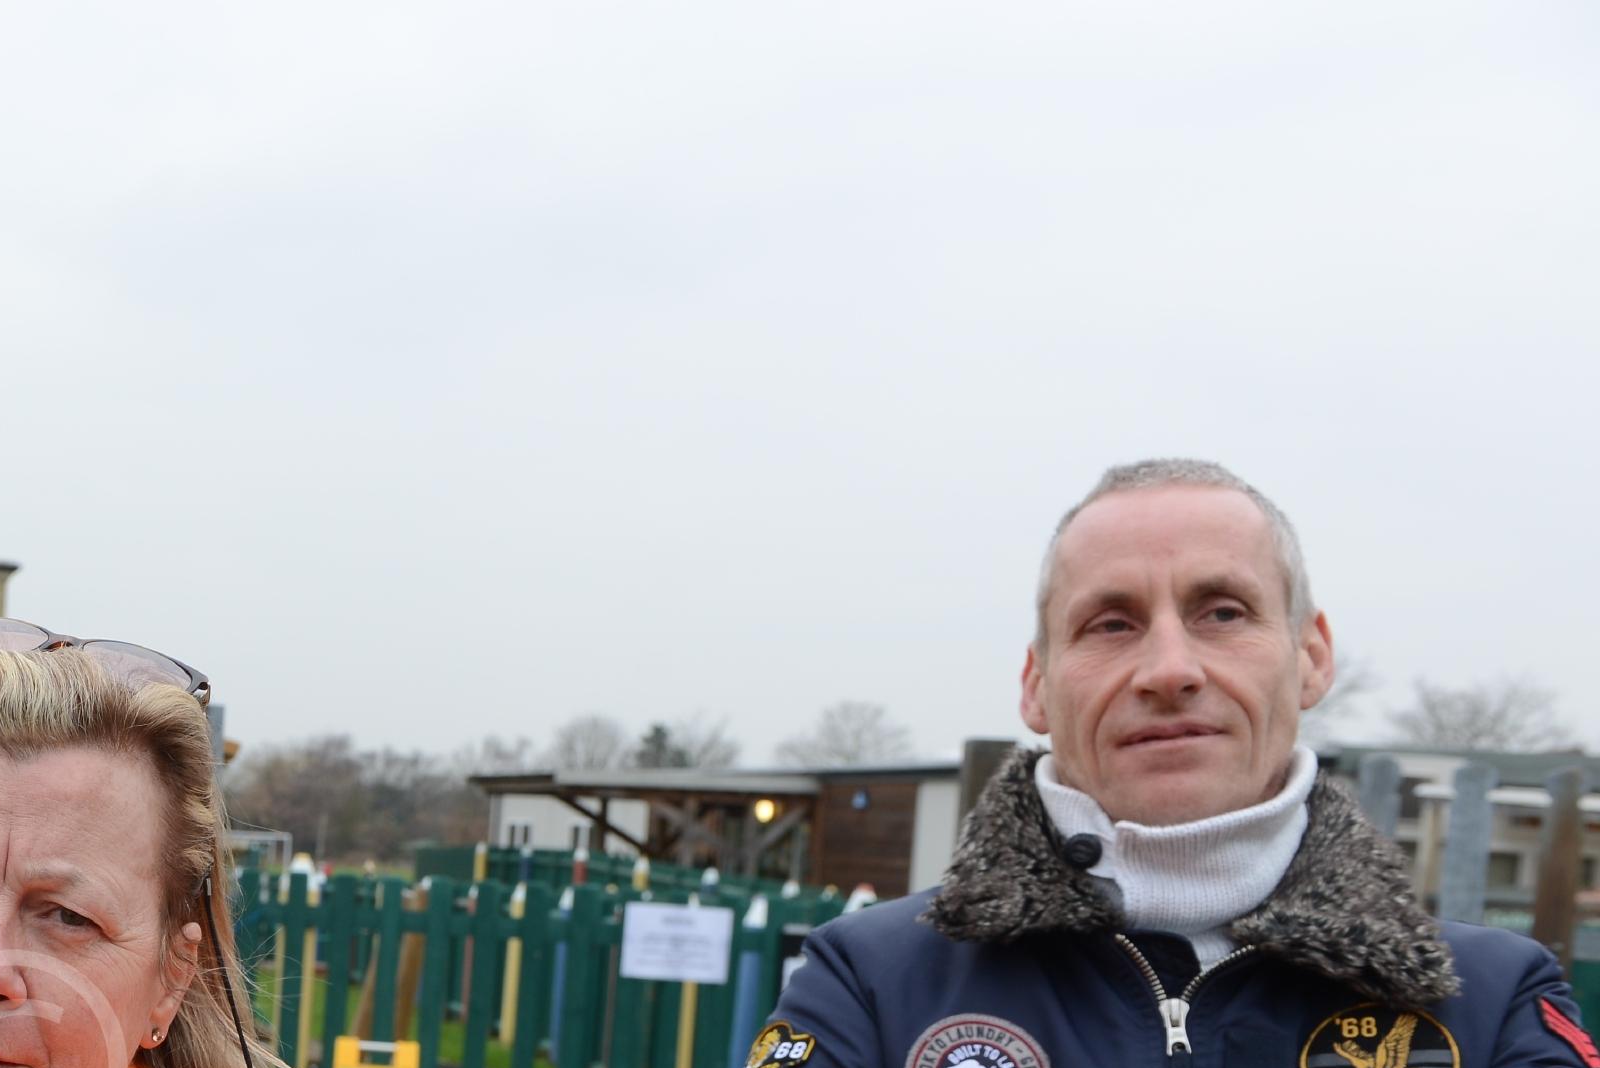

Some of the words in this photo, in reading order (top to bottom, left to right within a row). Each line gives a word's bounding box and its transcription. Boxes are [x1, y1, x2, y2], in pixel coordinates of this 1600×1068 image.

[947, 1026, 1015, 1048] LAUNDRY
[774, 1041, 807, 1059] 68
[947, 1044, 982, 1065] BUILT
[983, 1045, 1001, 1061] TO
